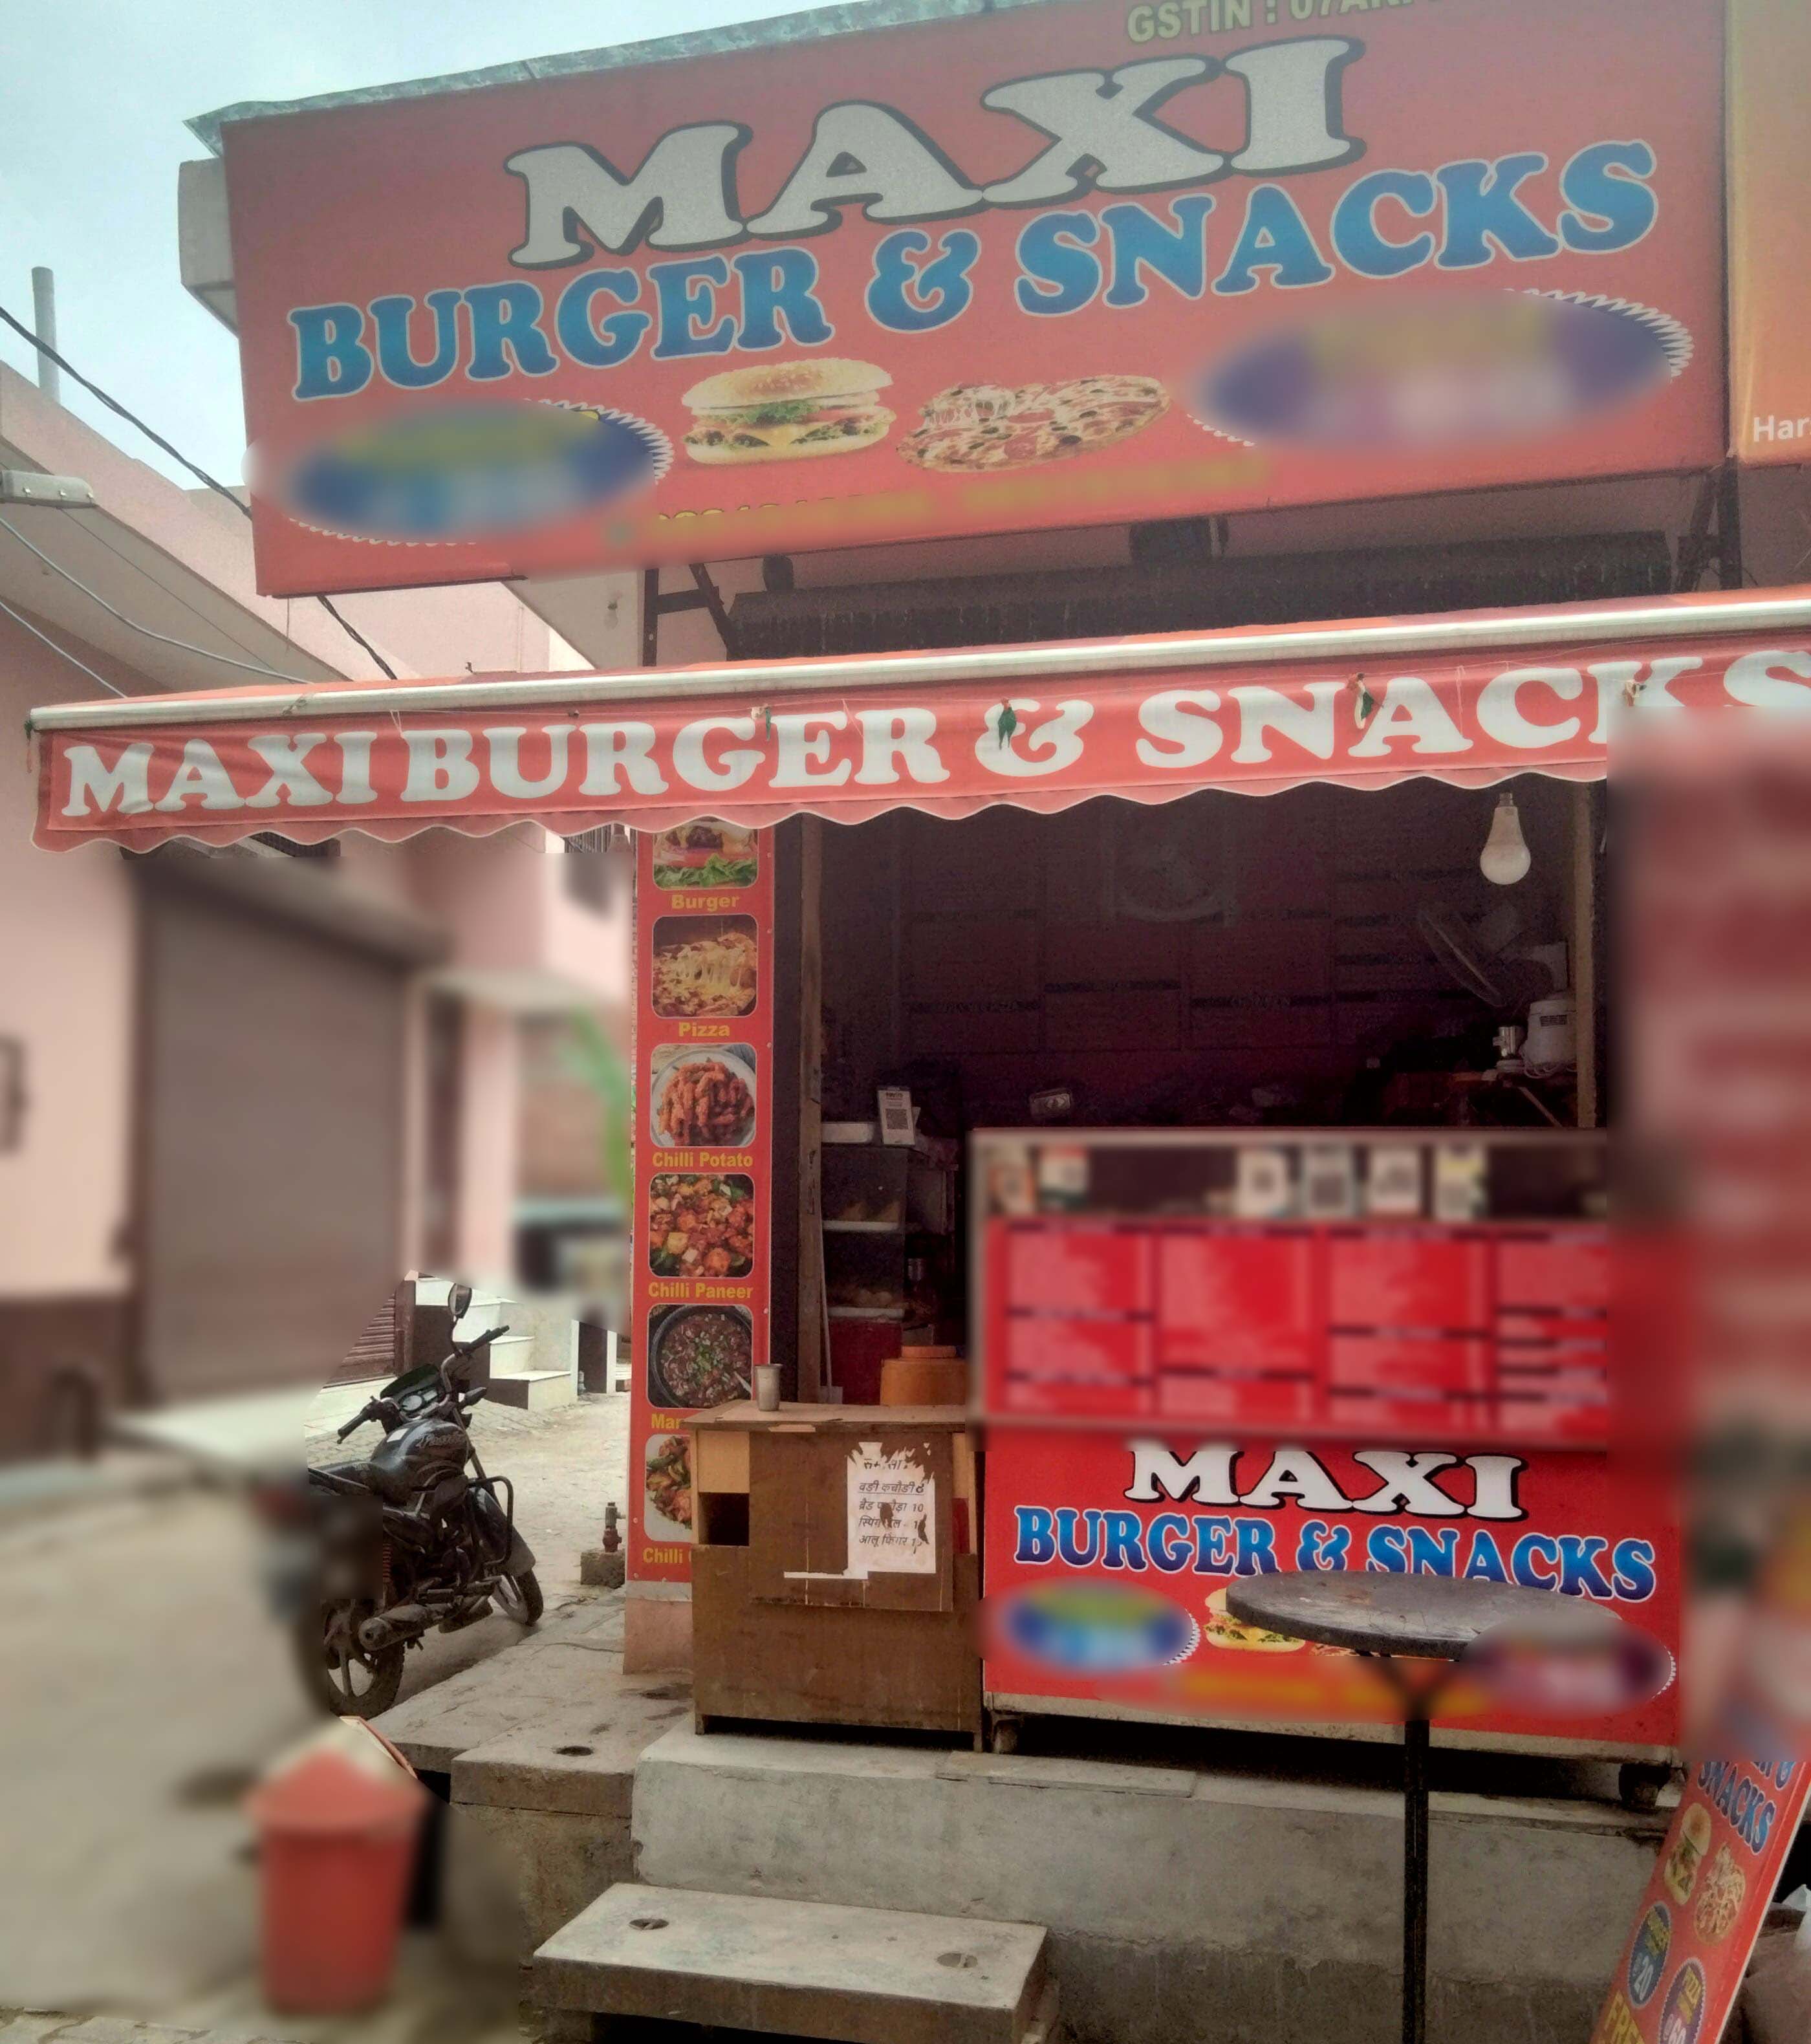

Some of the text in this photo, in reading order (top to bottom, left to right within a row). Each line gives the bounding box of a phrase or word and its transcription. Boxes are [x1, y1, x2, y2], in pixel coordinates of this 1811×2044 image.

[1127, 0, 1252, 43] GSTIN
[504, 36, 1367, 269] MAXI
[289, 139, 1658, 402] BURGER & SNACKS
[1753, 415, 1811, 442] Har
[61, 731, 378, 817] MAXI
[400, 708, 951, 803] BURGER
[975, 699, 1094, 777] &
[671, 894, 741, 911] Burger
[678, 1022, 731, 1037] Pizza
[652, 1151, 754, 1168] Chilli Potato
[648, 1281, 754, 1299] Chilli Paneer
[1124, 1440, 1530, 1522] MAXI
[913, 1503, 924, 1512] 10
[643, 1547, 683, 1564] Chilli
[1014, 1505, 1656, 1603] BURGER & SNACKS
